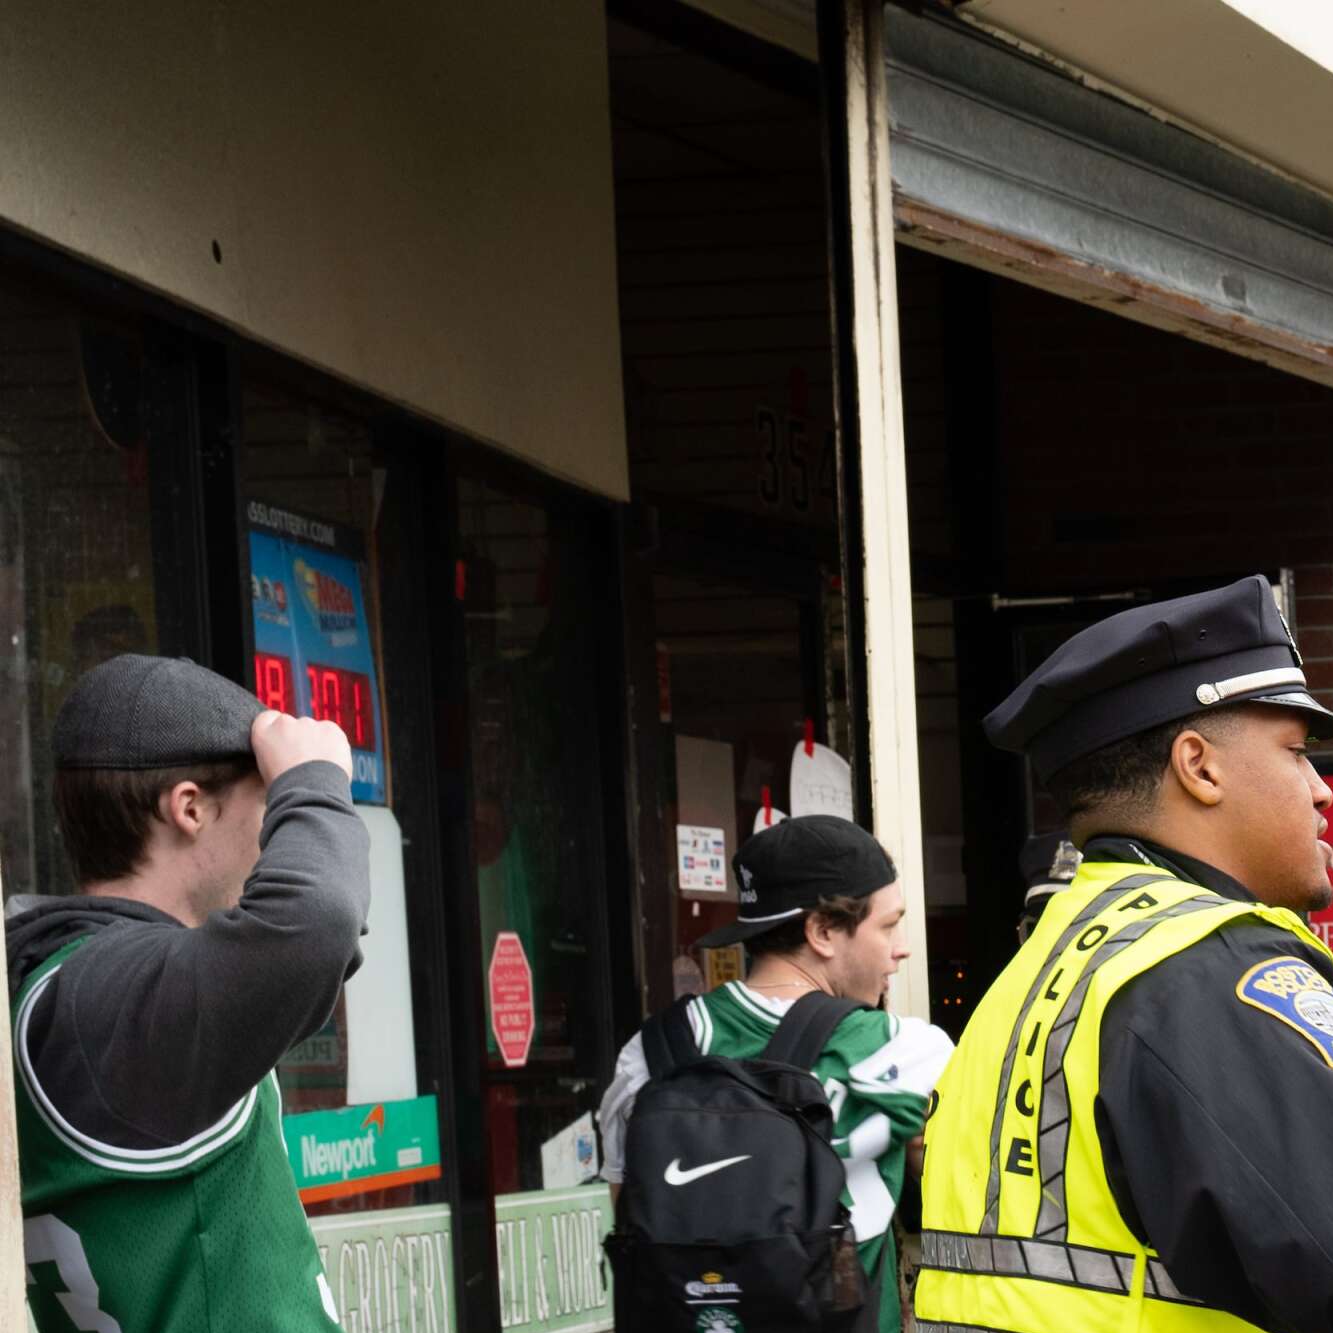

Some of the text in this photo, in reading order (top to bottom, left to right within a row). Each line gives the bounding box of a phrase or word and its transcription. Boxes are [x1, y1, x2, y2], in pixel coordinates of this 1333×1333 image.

[1005, 892, 1159, 1177] POLICE
[301, 1128, 377, 1180] Newport
[534, 1213, 551, 1322] &
[552, 1208, 606, 1316] MORE
